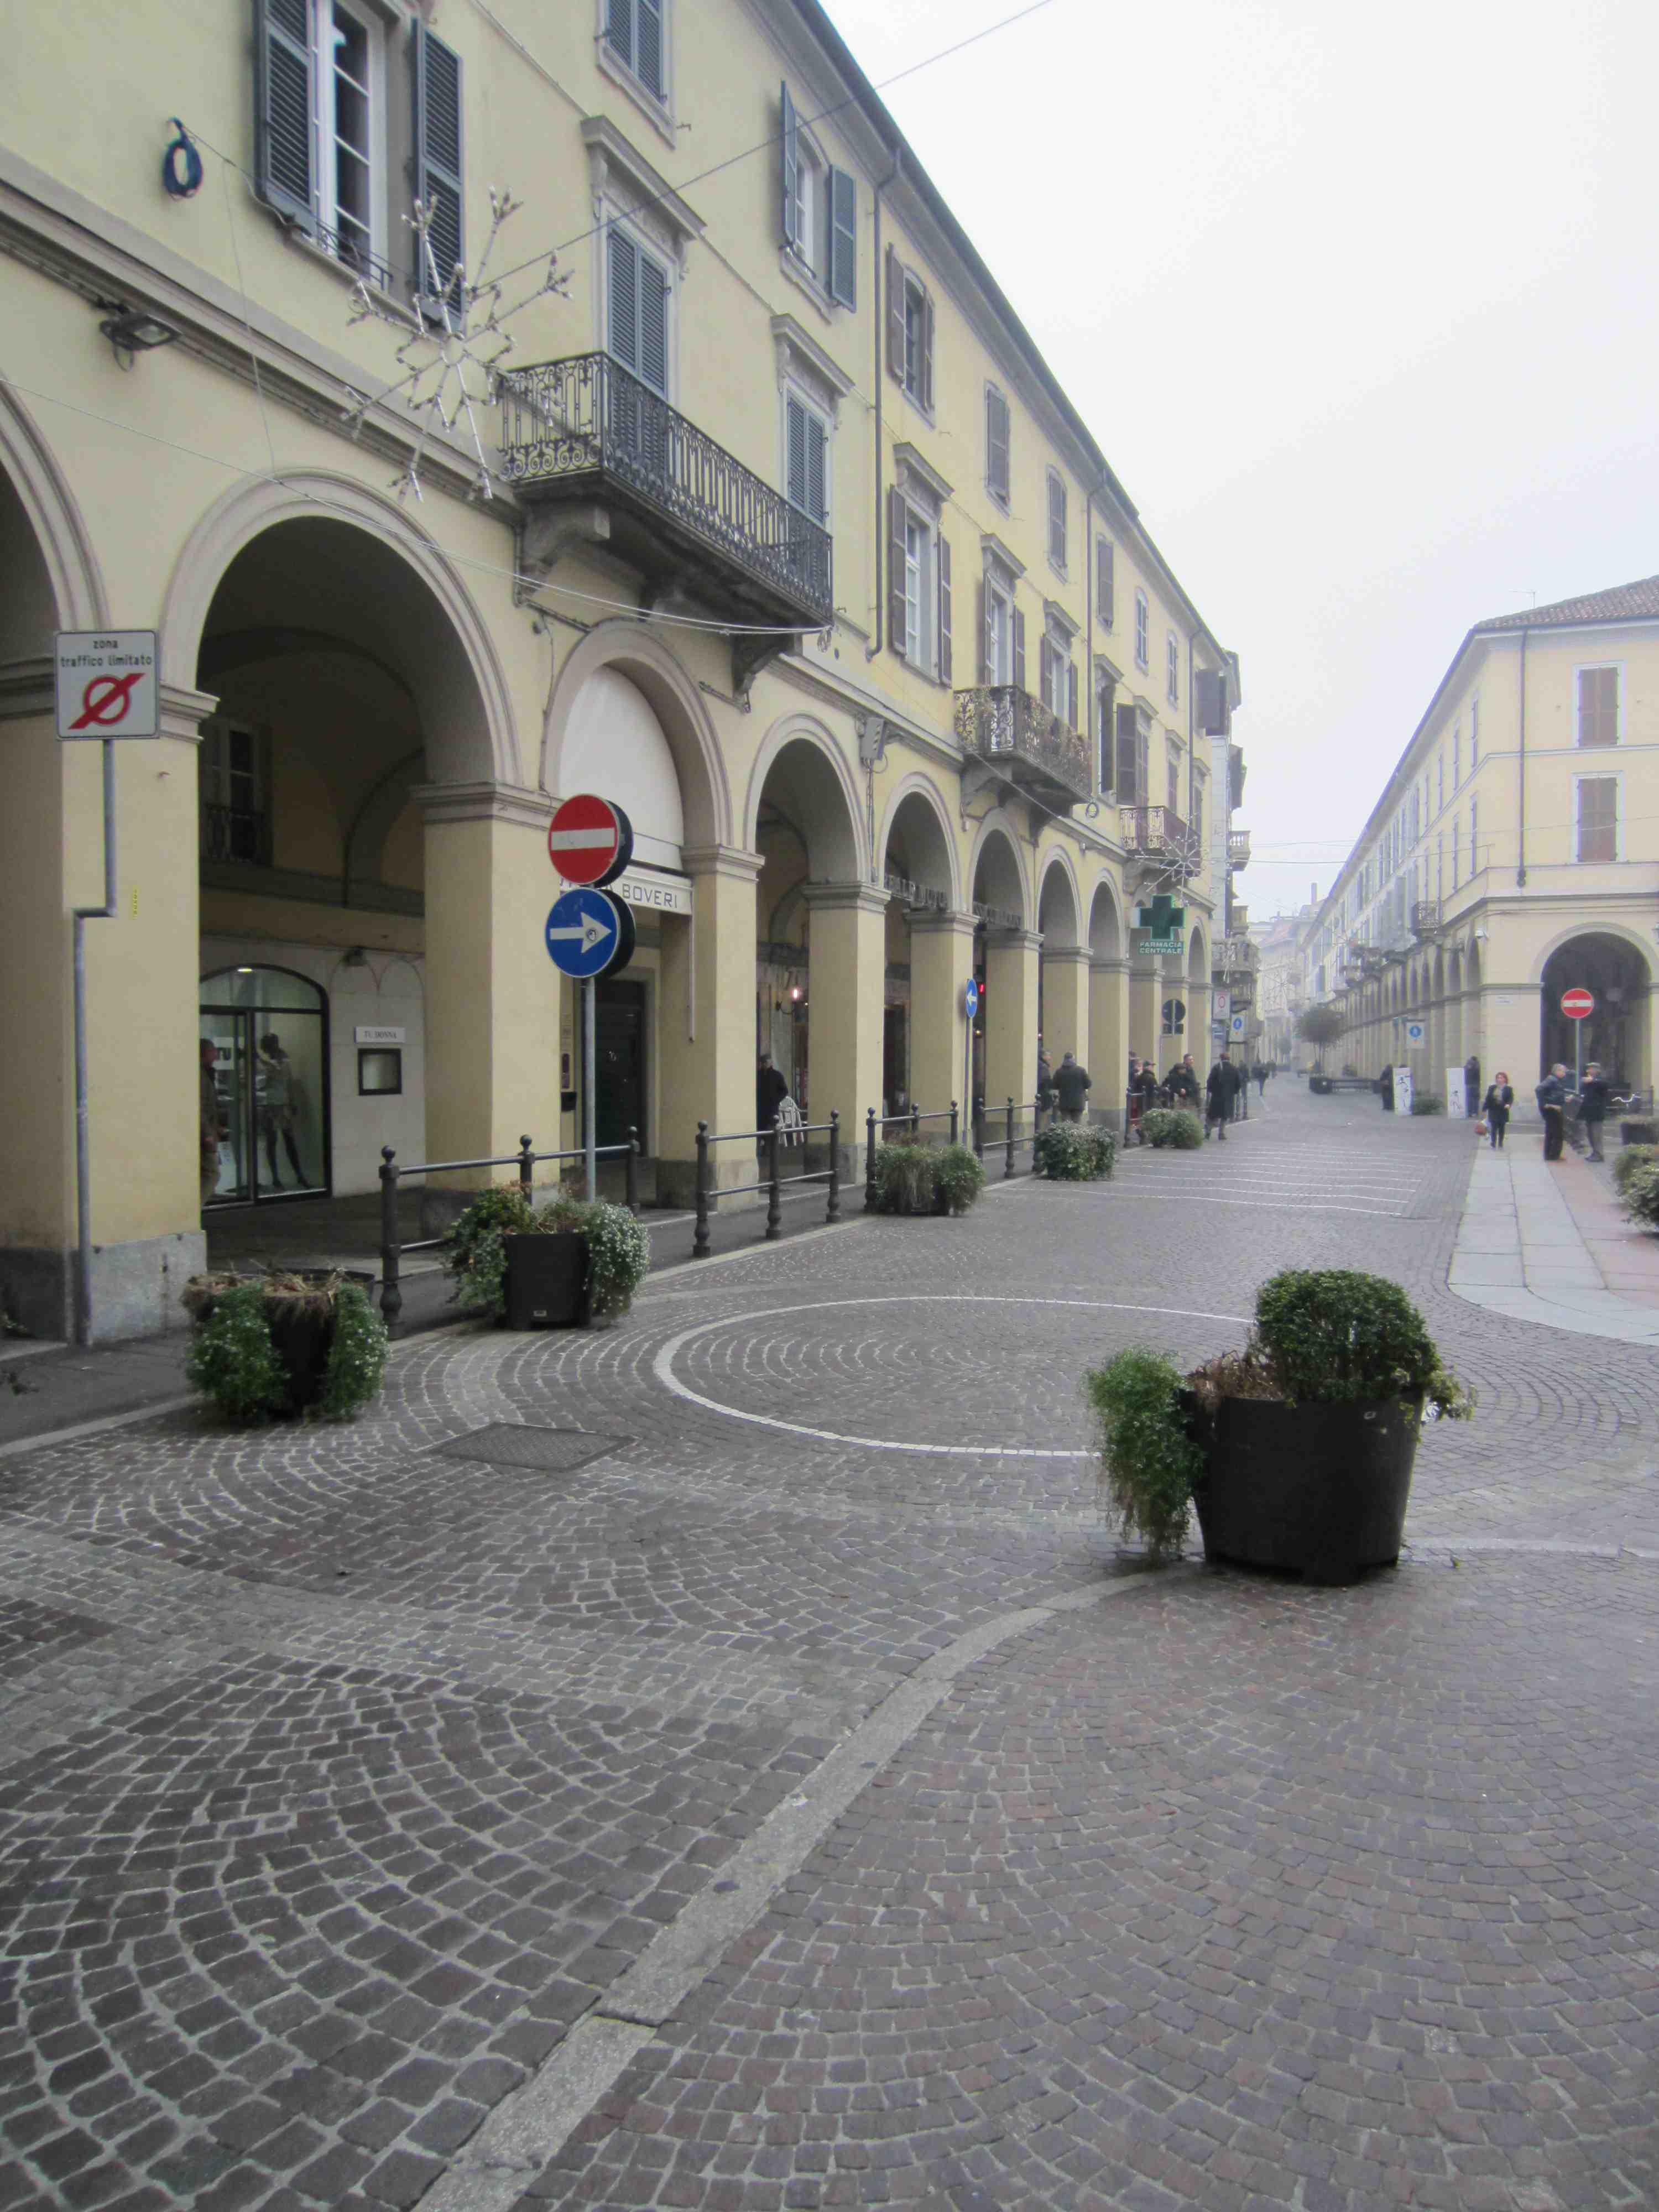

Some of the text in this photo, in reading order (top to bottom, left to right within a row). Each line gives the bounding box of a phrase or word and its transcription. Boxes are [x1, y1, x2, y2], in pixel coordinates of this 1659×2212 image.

[93, 640, 118, 649] zona
[60, 653, 152, 667] traffico limitato
[623, 883, 677, 909] BOVERI
